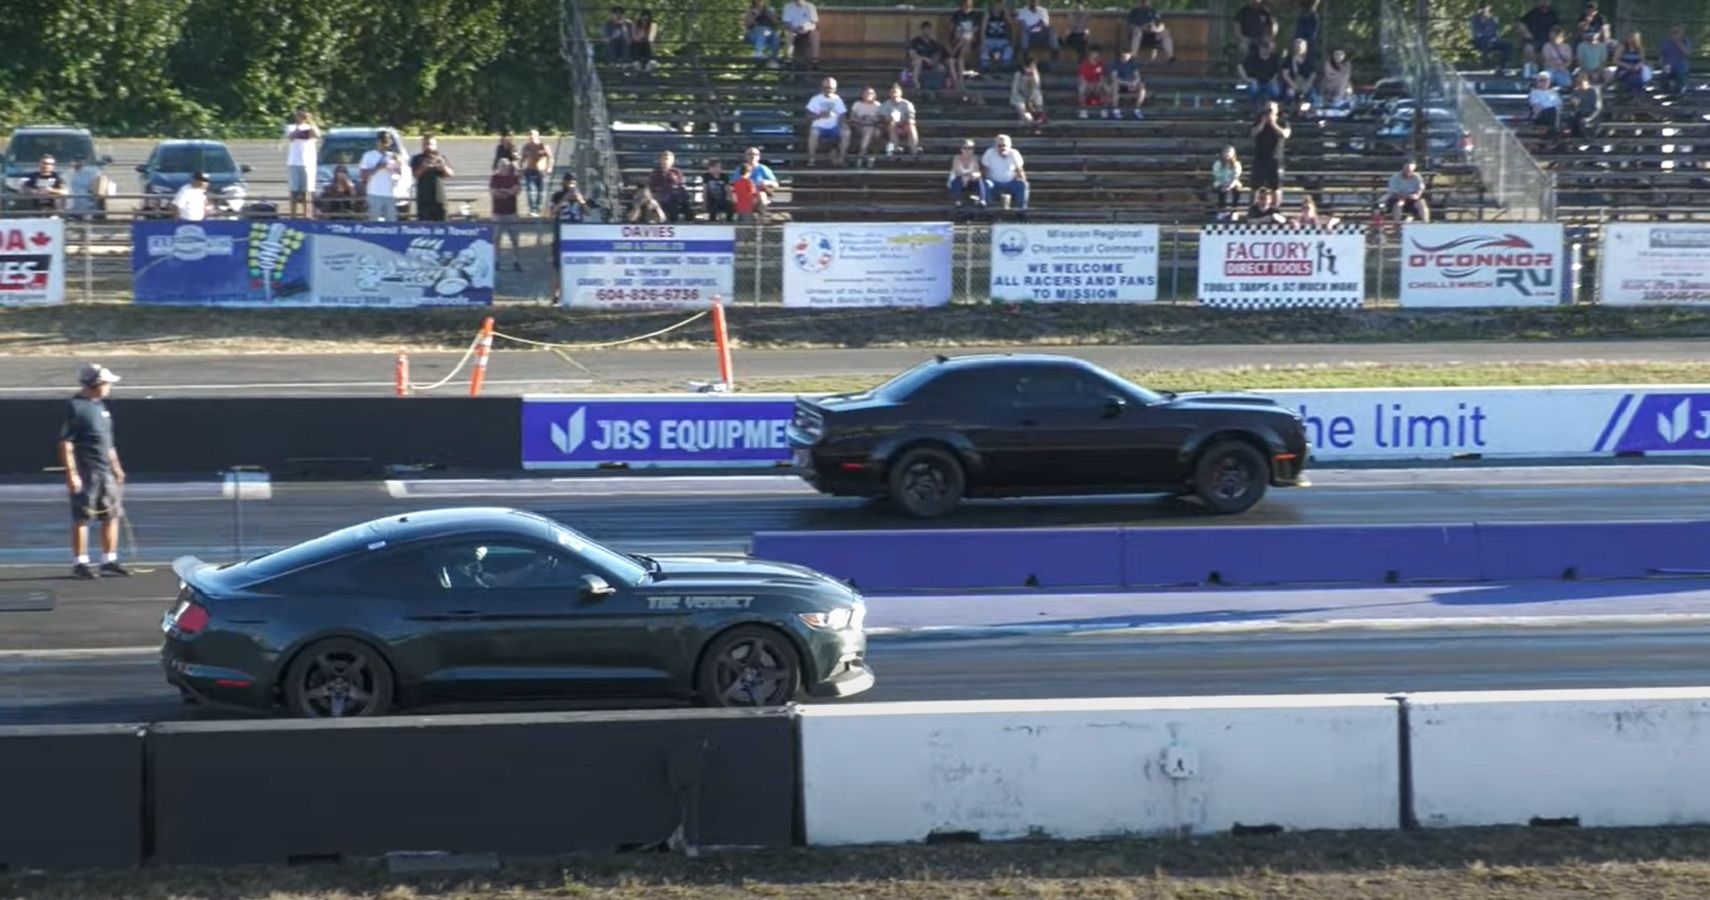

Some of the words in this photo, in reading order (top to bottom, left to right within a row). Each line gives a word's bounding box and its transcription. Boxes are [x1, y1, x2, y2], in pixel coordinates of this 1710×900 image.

[622, 227, 675, 238] DAVIES
[1048, 229, 1090, 238] Mission
[1093, 229, 1142, 240] Regional
[1031, 244, 1081, 254] Chamber
[1083, 244, 1094, 253] of
[1096, 244, 1155, 255] Commerce
[1226, 242, 1312, 260] FACTORY
[1409, 254, 1553, 267] O'CONNOR
[1027, 263, 1049, 273] WE
[1054, 263, 1124, 273] WELCOME
[1227, 263, 1267, 275] DIRECT
[1271, 263, 1311, 275] TOOLS
[994, 276, 1019, 286] ALL
[1024, 276, 1082, 286] RACERS
[1086, 276, 1115, 286] AND
[1119, 276, 1156, 286] FANS
[1496, 268, 1553, 297] RV
[1239, 283, 1270, 292] TARPS
[1297, 283, 1327, 292] MUCH
[1330, 283, 1358, 292] MORE
[597, 289, 699, 300] 604-826-6736
[1032, 289, 1051, 299] TO
[1055, 289, 1118, 299] MISSION
[1300, 404, 1355, 448] he
[1375, 402, 1486, 448] limit
[591, 420, 651, 449] JBS
[660, 419, 792, 452] EQUIPME
[647, 596, 680, 609] THE
[684, 595, 755, 609] VERDICT
